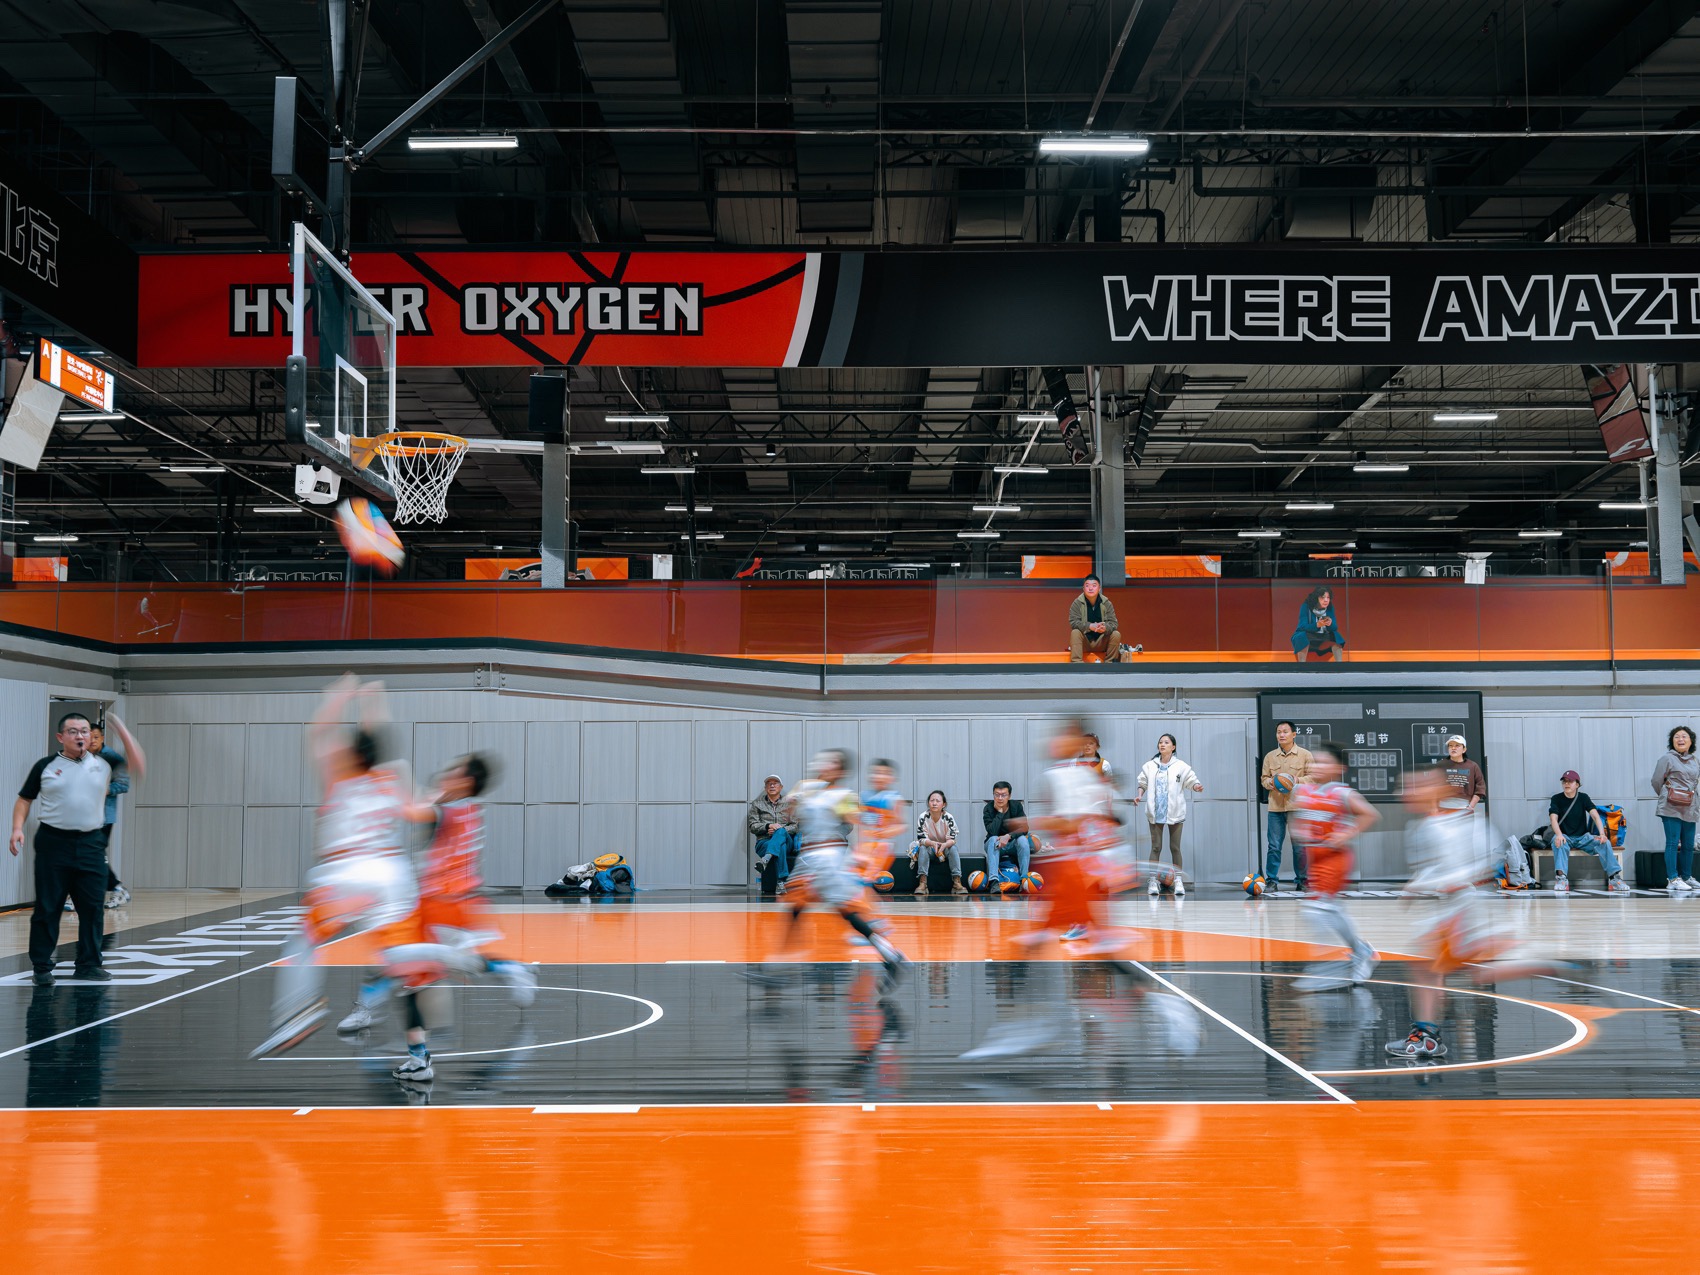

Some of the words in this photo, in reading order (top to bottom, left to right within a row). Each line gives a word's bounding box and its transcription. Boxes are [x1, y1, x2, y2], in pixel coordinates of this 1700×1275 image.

[232, 286, 429, 334] HYER
[463, 286, 700, 332] OXYGEN
[1103, 275, 1391, 341] WHERE
[42, 342, 51, 359] A
